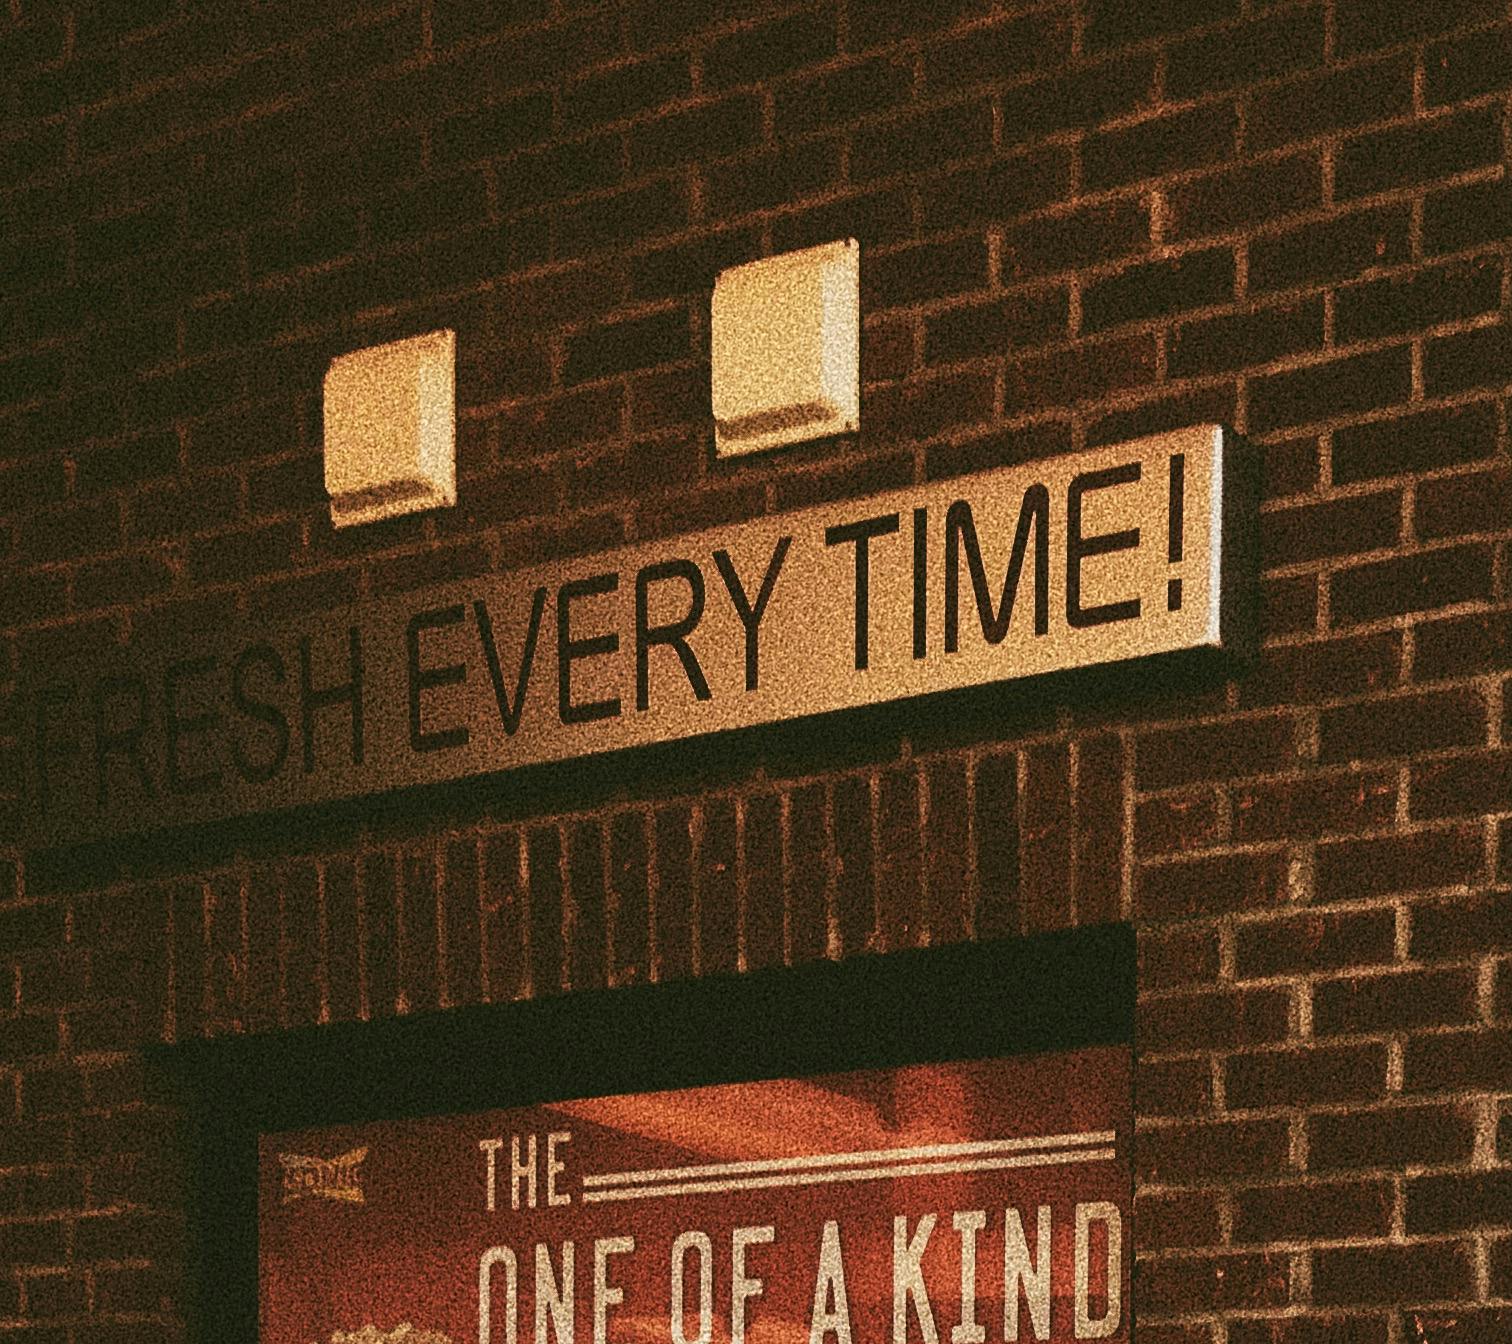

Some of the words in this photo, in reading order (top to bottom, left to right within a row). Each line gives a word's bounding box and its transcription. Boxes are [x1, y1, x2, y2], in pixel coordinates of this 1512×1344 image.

[36, 626, 366, 815] FRESH
[407, 535, 792, 755] EVERY
[824, 452, 1186, 671] TIME!
[479, 1131, 572, 1212] THE
